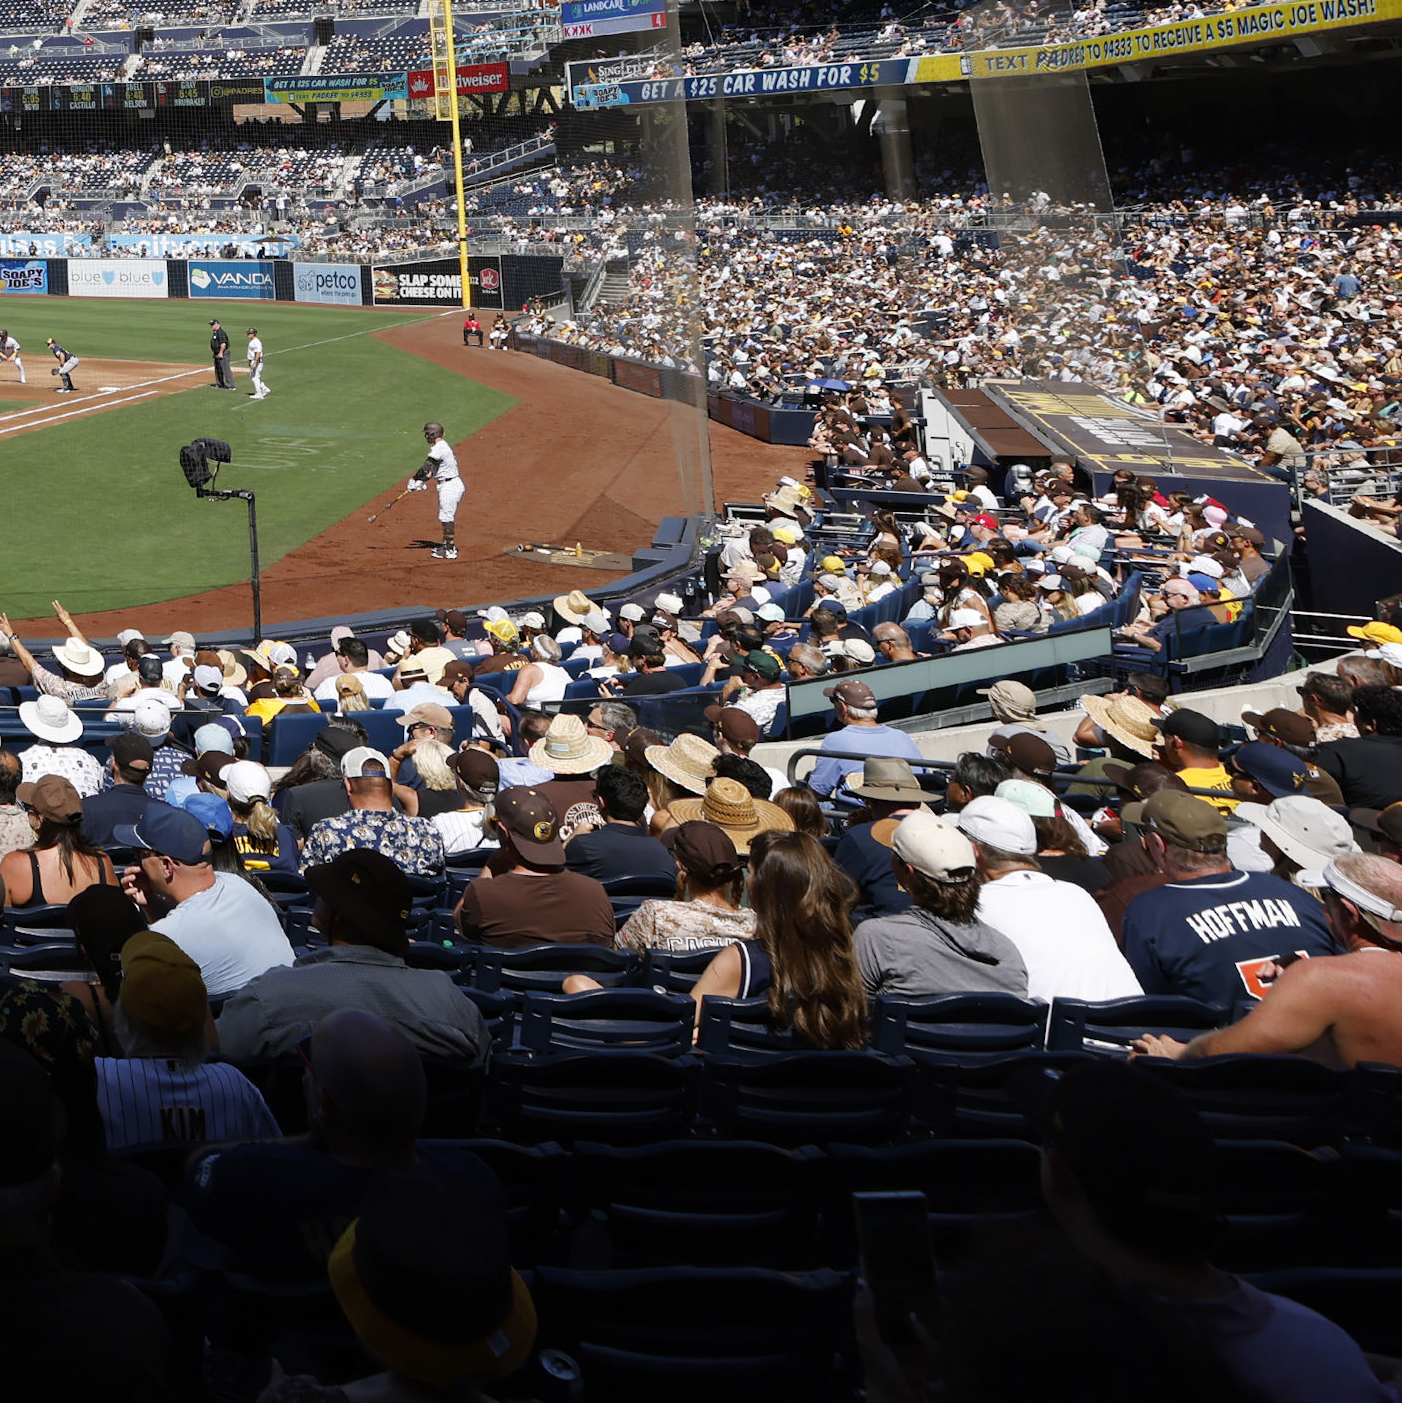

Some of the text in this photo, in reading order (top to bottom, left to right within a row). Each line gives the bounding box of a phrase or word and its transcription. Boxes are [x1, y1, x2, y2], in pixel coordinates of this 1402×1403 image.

[985, 54, 1029, 72] TEXT
[1135, 35, 1150, 53] TO
[1154, 26, 1203, 51] RECEIVE
[1237, 9, 1285, 37] MAGIC
[1289, 3, 1318, 27] JOE
[641, 62, 879, 100] GET $25 CAR WASH FOR $5
[2, 268, 44, 281] SOAPY
[71, 270, 150, 282] blue blue
[210, 273, 273, 285] VANDA
[399, 274, 462, 287] SLAP SOME
[7, 278, 44, 289] JOE'S
[316, 272, 357, 292] petco
[399, 287, 453, 298] CHEESE ON
[1186, 899, 1302, 944] HOFFMAN
